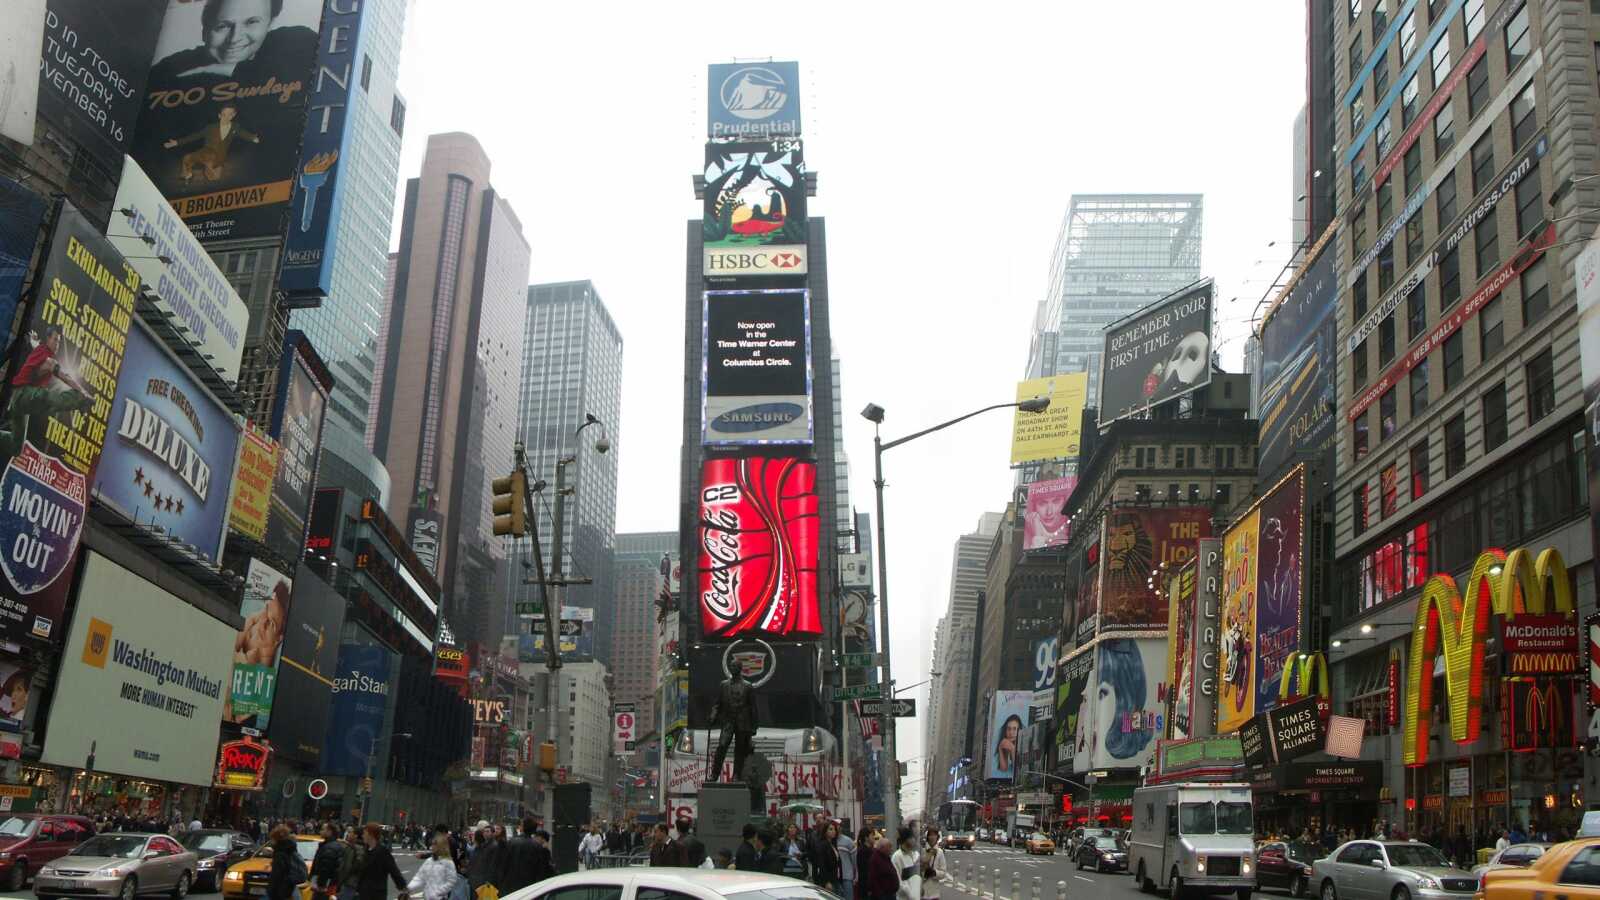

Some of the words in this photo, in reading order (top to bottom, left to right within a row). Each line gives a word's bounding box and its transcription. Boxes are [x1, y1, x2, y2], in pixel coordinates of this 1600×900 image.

[47, 35, 113, 110] TUESDAY,
[80, 47, 135, 98] STORES
[150, 87, 205, 109] 700
[211, 76, 302, 103] Sundays
[110, 120, 124, 142] 16
[712, 119, 797, 135] Prudential
[770, 141, 801, 153] 1:34
[185, 186, 268, 215] BROADWAY
[1446, 155, 1531, 251] mattress.com
[155, 202, 177, 241] THE
[205, 218, 236, 230] Theatre
[207, 228, 231, 238] Street
[176, 225, 230, 309] UNDISPUTED
[708, 253, 768, 270] HSBC
[66, 236, 135, 313] EXHILARATING
[128, 203, 200, 300] HEAVYWEIGHT
[199, 290, 239, 350] CHECKING
[110, 304, 130, 334] AND
[737, 321, 754, 330] Now
[755, 322, 775, 332] open
[1110, 313, 1171, 352] REMEMBER
[1173, 296, 1206, 321] YOUR
[41, 298, 57, 325] IT
[57, 308, 122, 377] PRACTICALLY
[717, 340, 738, 348] Time
[738, 340, 767, 348] Warner
[768, 339, 796, 348] Center
[746, 330, 753, 338] in
[754, 330, 767, 338] the
[1412, 342, 1431, 361] WEB
[1431, 321, 1455, 346] WALL
[722, 358, 765, 367] Columbus
[766, 358, 792, 366] Circle.
[1109, 345, 1140, 371] FIRST
[78, 352, 116, 399] BURSTS
[147, 378, 171, 397] FREE
[170, 387, 204, 444] CHECKING
[722, 412, 793, 423] SAMSUNG
[1017, 417, 1050, 426] BROADWAY
[1050, 414, 1069, 422] SHOW
[1049, 407, 1069, 415] GREAT
[1288, 394, 1328, 447] POLAR
[87, 416, 107, 447] THE
[1015, 434, 1032, 442] DALE
[1016, 426, 1026, 434] ON
[117, 397, 211, 502] DELUXE
[26, 456, 57, 485] THARP
[65, 479, 84, 502] JOEL
[702, 485, 740, 504] C2
[1168, 522, 1199, 540] THE
[12, 532, 55, 574] OUT
[1201, 551, 1217, 696] PALACE
[1505, 625, 1577, 639] McDonald's
[1517, 639, 1565, 648] Restaurant
[113, 639, 185, 687] Washington
[185, 669, 222, 700] Mutual
[232, 668, 274, 699] RENT
[120, 682, 142, 705] MORE
[141, 689, 166, 711] HUMAN
[165, 696, 195, 720] INTEREST
[1279, 709, 1311, 728] TIMES
[1243, 725, 1258, 739] TIMES
[1278, 720, 1317, 741] SQUARE
[1243, 735, 1262, 750] SQUARE
[1282, 733, 1317, 751] ALLIANCE
[1306, 776, 1343, 785] INFORMATION
[1315, 768, 1333, 776] TIMES
[1334, 767, 1355, 775] SQUARE
